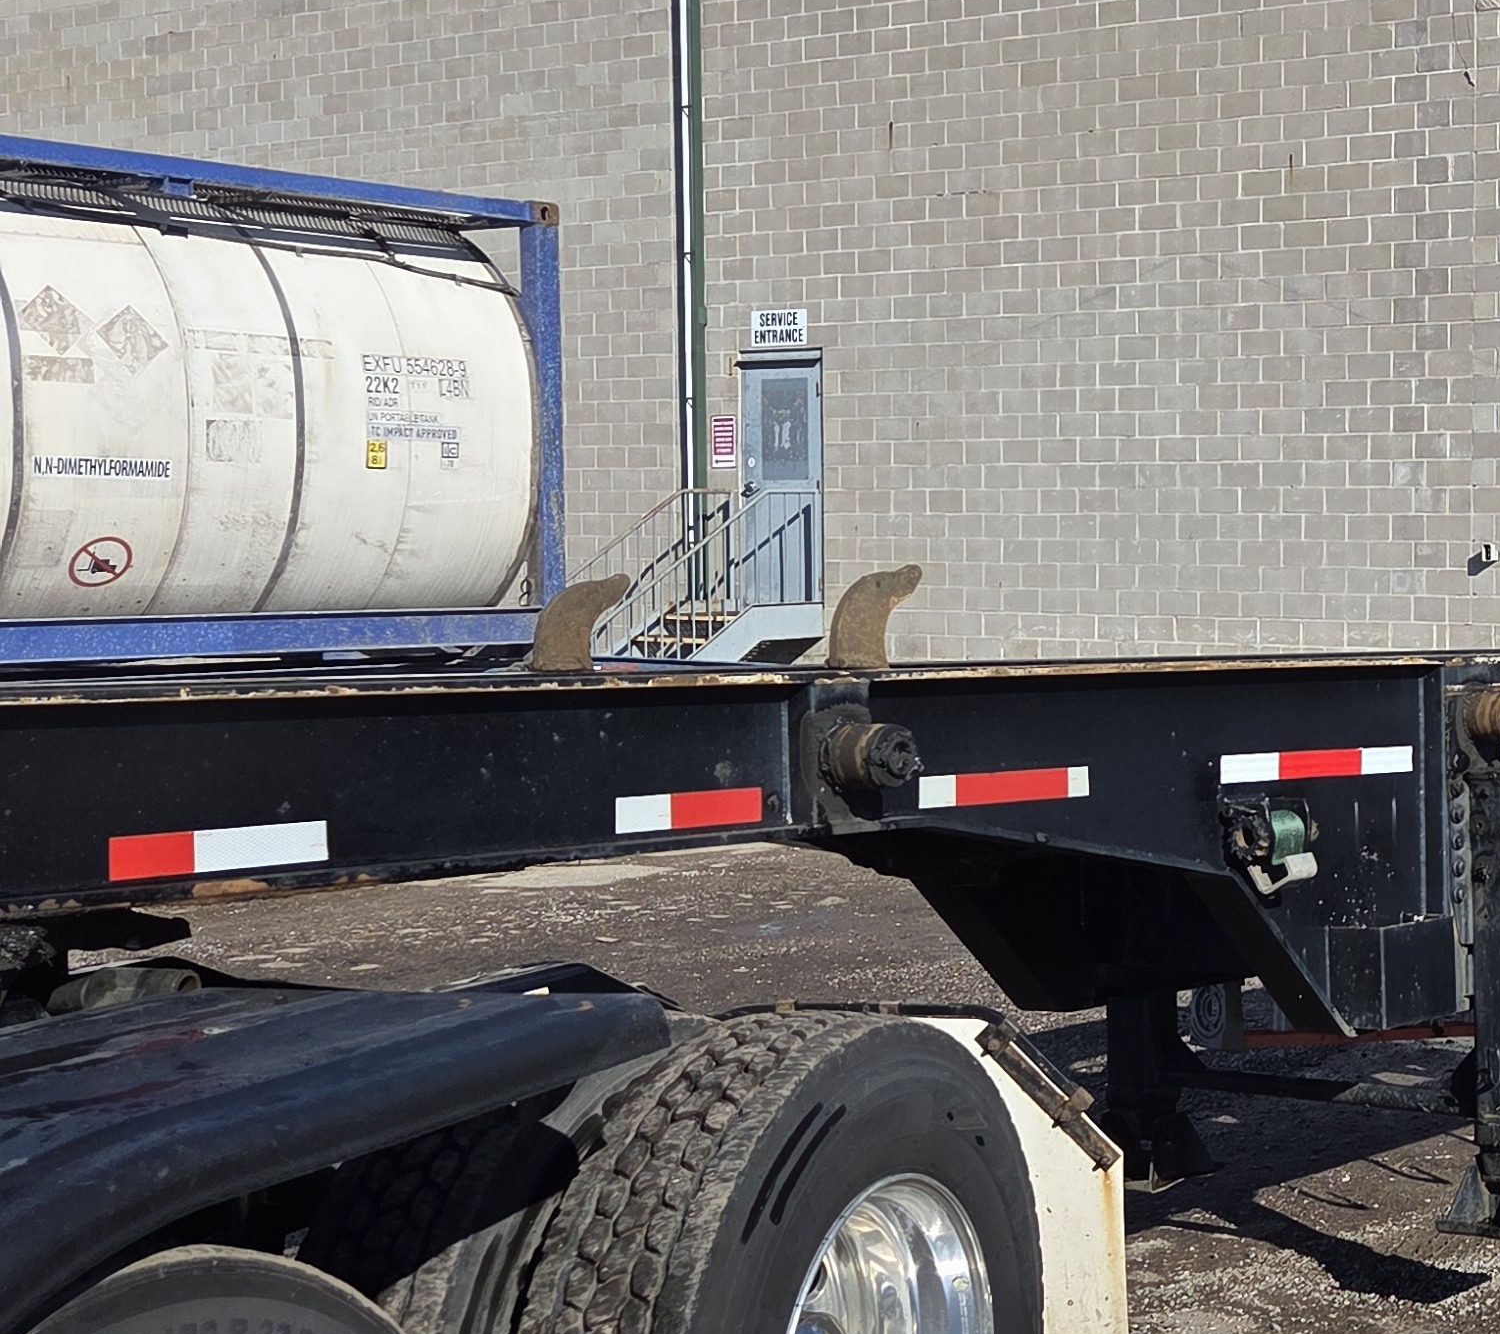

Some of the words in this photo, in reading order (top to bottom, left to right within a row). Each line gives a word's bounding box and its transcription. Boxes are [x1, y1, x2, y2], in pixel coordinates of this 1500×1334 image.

[759, 311, 799, 327] SERVICE
[754, 328, 804, 344] ENTRANCE
[362, 354, 402, 373] EXFU
[406, 358, 467, 378] 554628-9
[365, 375, 400, 394] 22K2
[34, 456, 171, 478] N,N-DIMETHYLFORMAMIDE
